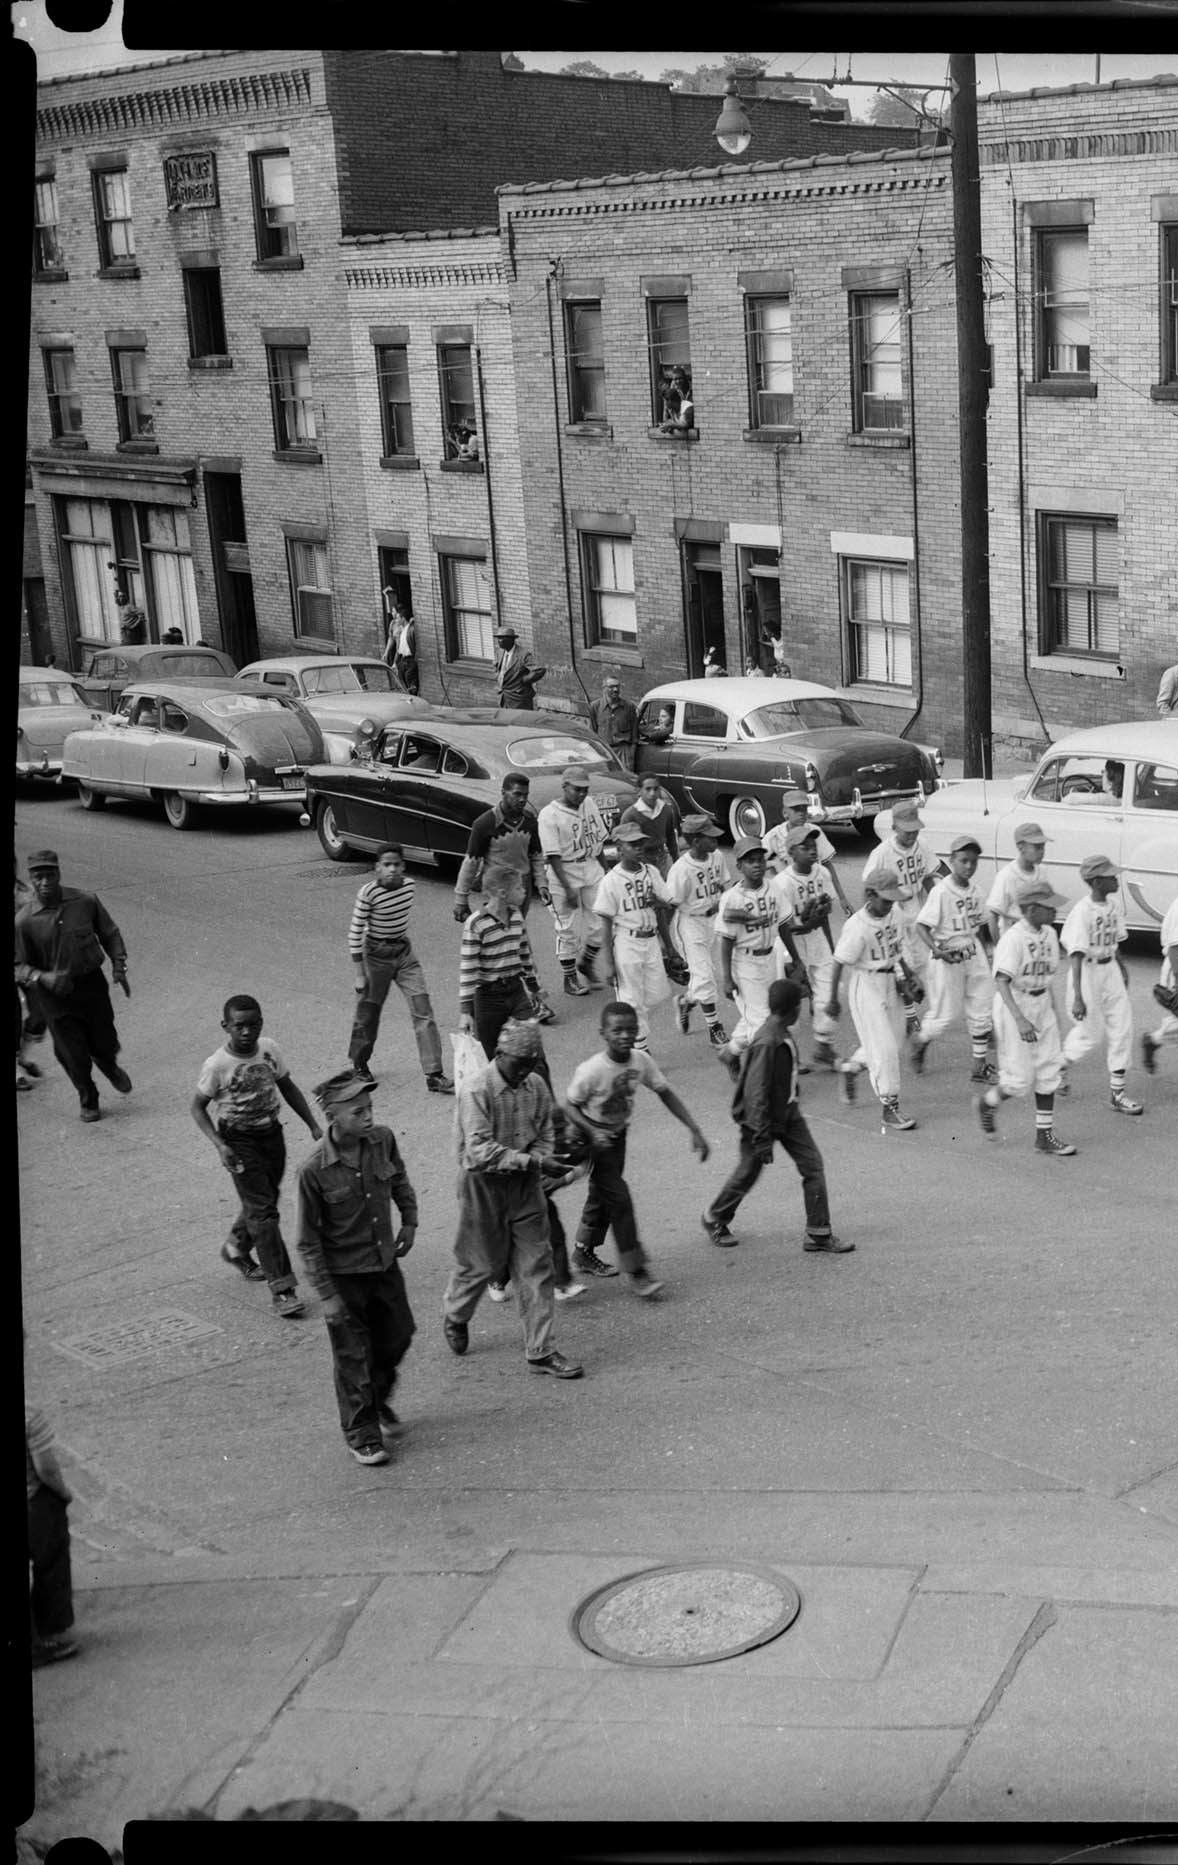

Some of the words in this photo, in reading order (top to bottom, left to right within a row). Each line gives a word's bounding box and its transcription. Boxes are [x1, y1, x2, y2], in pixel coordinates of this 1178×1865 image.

[896, 856, 922, 872] PGH
[696, 865, 721, 885] PGH
[624, 880, 653, 897] PGH
[798, 880, 823, 900] PGH
[745, 897, 777, 913] PGH
